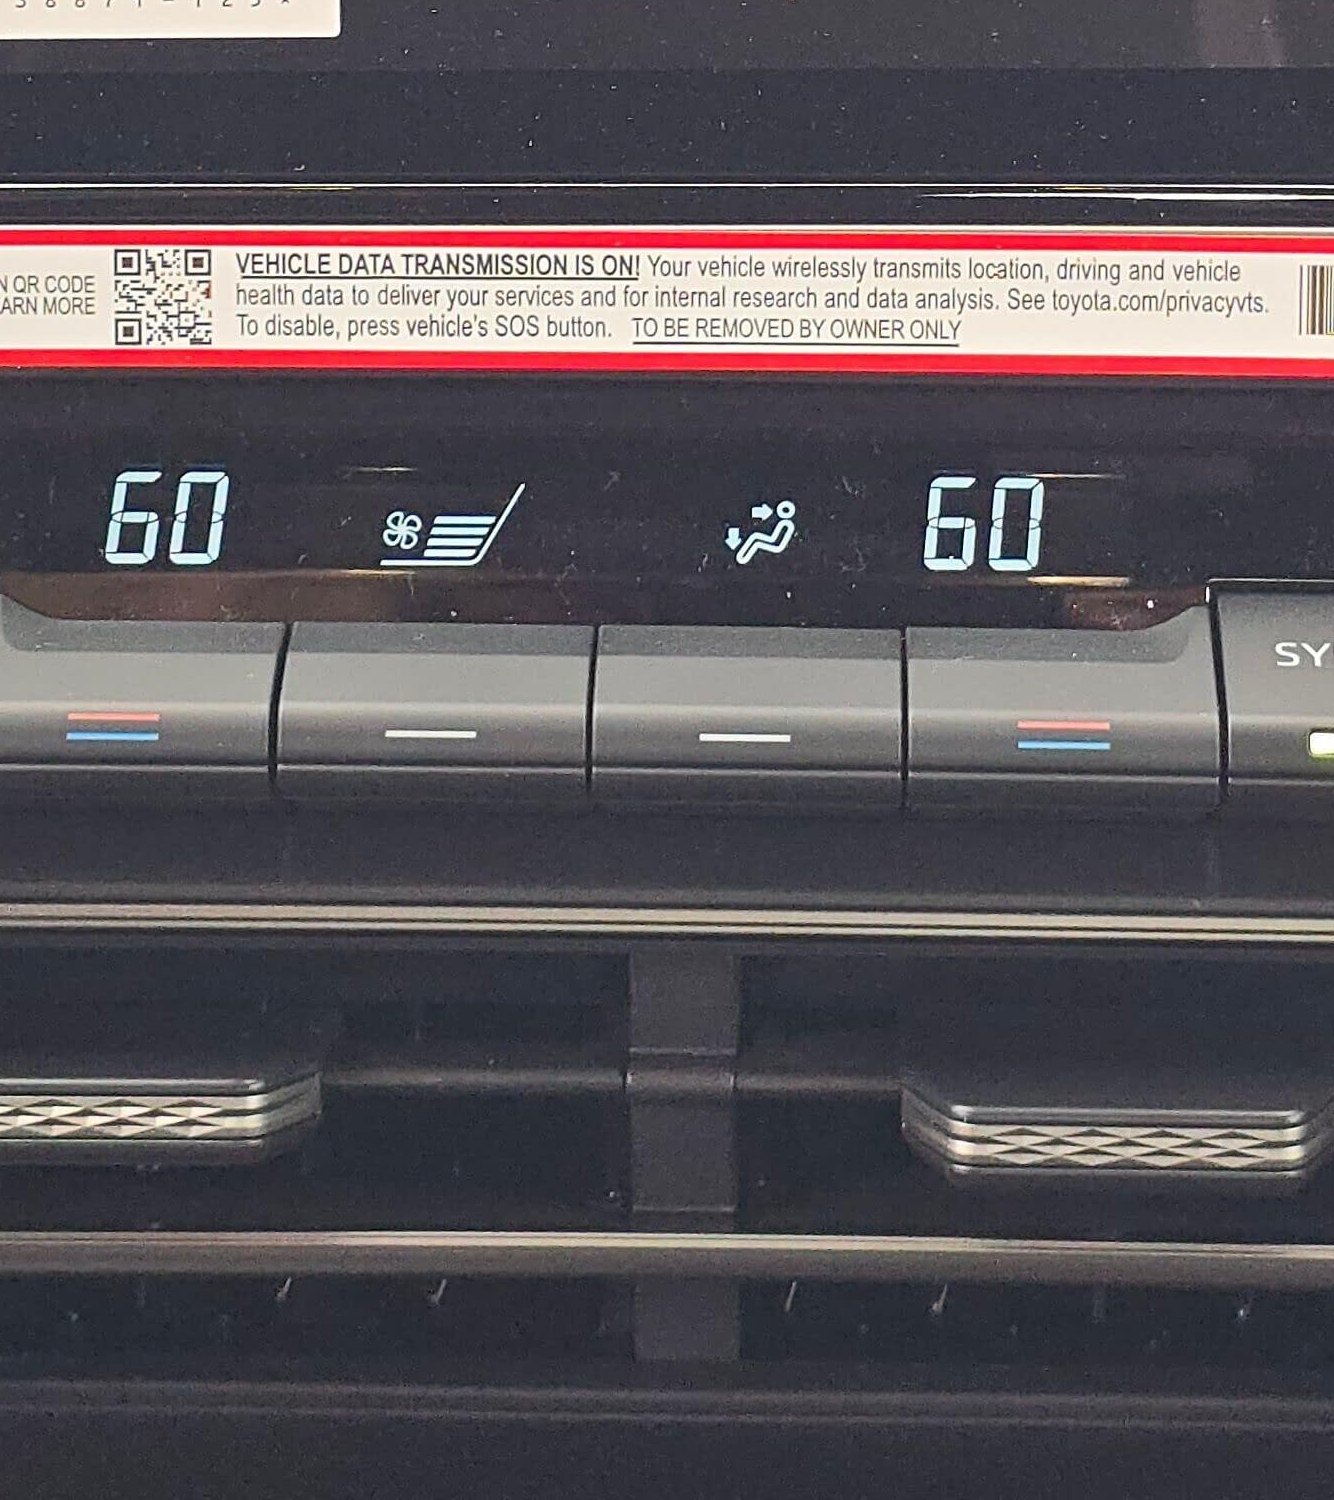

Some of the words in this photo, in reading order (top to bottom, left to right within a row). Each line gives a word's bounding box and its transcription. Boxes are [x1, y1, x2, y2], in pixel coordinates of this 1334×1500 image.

[12, 274, 41, 294] QR
[44, 274, 96, 294] CODE
[235, 252, 332, 275] VEHICLE
[338, 253, 396, 276] DATA
[400, 253, 568, 276] TRANSMISSION
[574, 254, 596, 276] IS
[600, 254, 641, 277] ON!
[647, 254, 692, 277] Your
[697, 254, 766, 278] vehicle
[771, 255, 867, 284] wirelessly
[873, 257, 962, 279] transmits
[968, 257, 1049, 283] location,
[1056, 257, 1121, 287] driving
[1128, 258, 1165, 281] and
[1172, 259, 1241, 282] vehicle
[44, 296, 96, 316] MORE
[236, 284, 295, 306] health
[301, 284, 344, 306] data
[351, 284, 370, 306] to
[377, 284, 440, 306] deliver
[446, 289, 489, 312] your
[494, 284, 575, 307] services
[580, 285, 616, 307] and
[623, 285, 650, 308] for
[655, 285, 726, 308] internal
[733, 286, 818, 309] research
[824, 286, 860, 309] and
[866, 286, 908, 309] data
[915, 286, 1000, 316] analysis.
[1007, 287, 1045, 311] See
[1052, 288, 1269, 319] toyota.com/privacyvts.
[235, 313, 259, 336] To
[265, 313, 340, 341] disable,
[347, 319, 400, 342] press
[406, 313, 489, 338] vehicle's
[494, 314, 540, 338] SOS
[546, 314, 612, 338] button.
[631, 317, 659, 338] TO
[664, 317, 690, 338] BE
[695, 317, 795, 338] REMOVED
[799, 318, 827, 339] BY
[829, 318, 905, 340] OWNER
[909, 319, 962, 340] ONLY
[101, 470, 230, 565] 60
[923, 474, 1047, 572] 60
